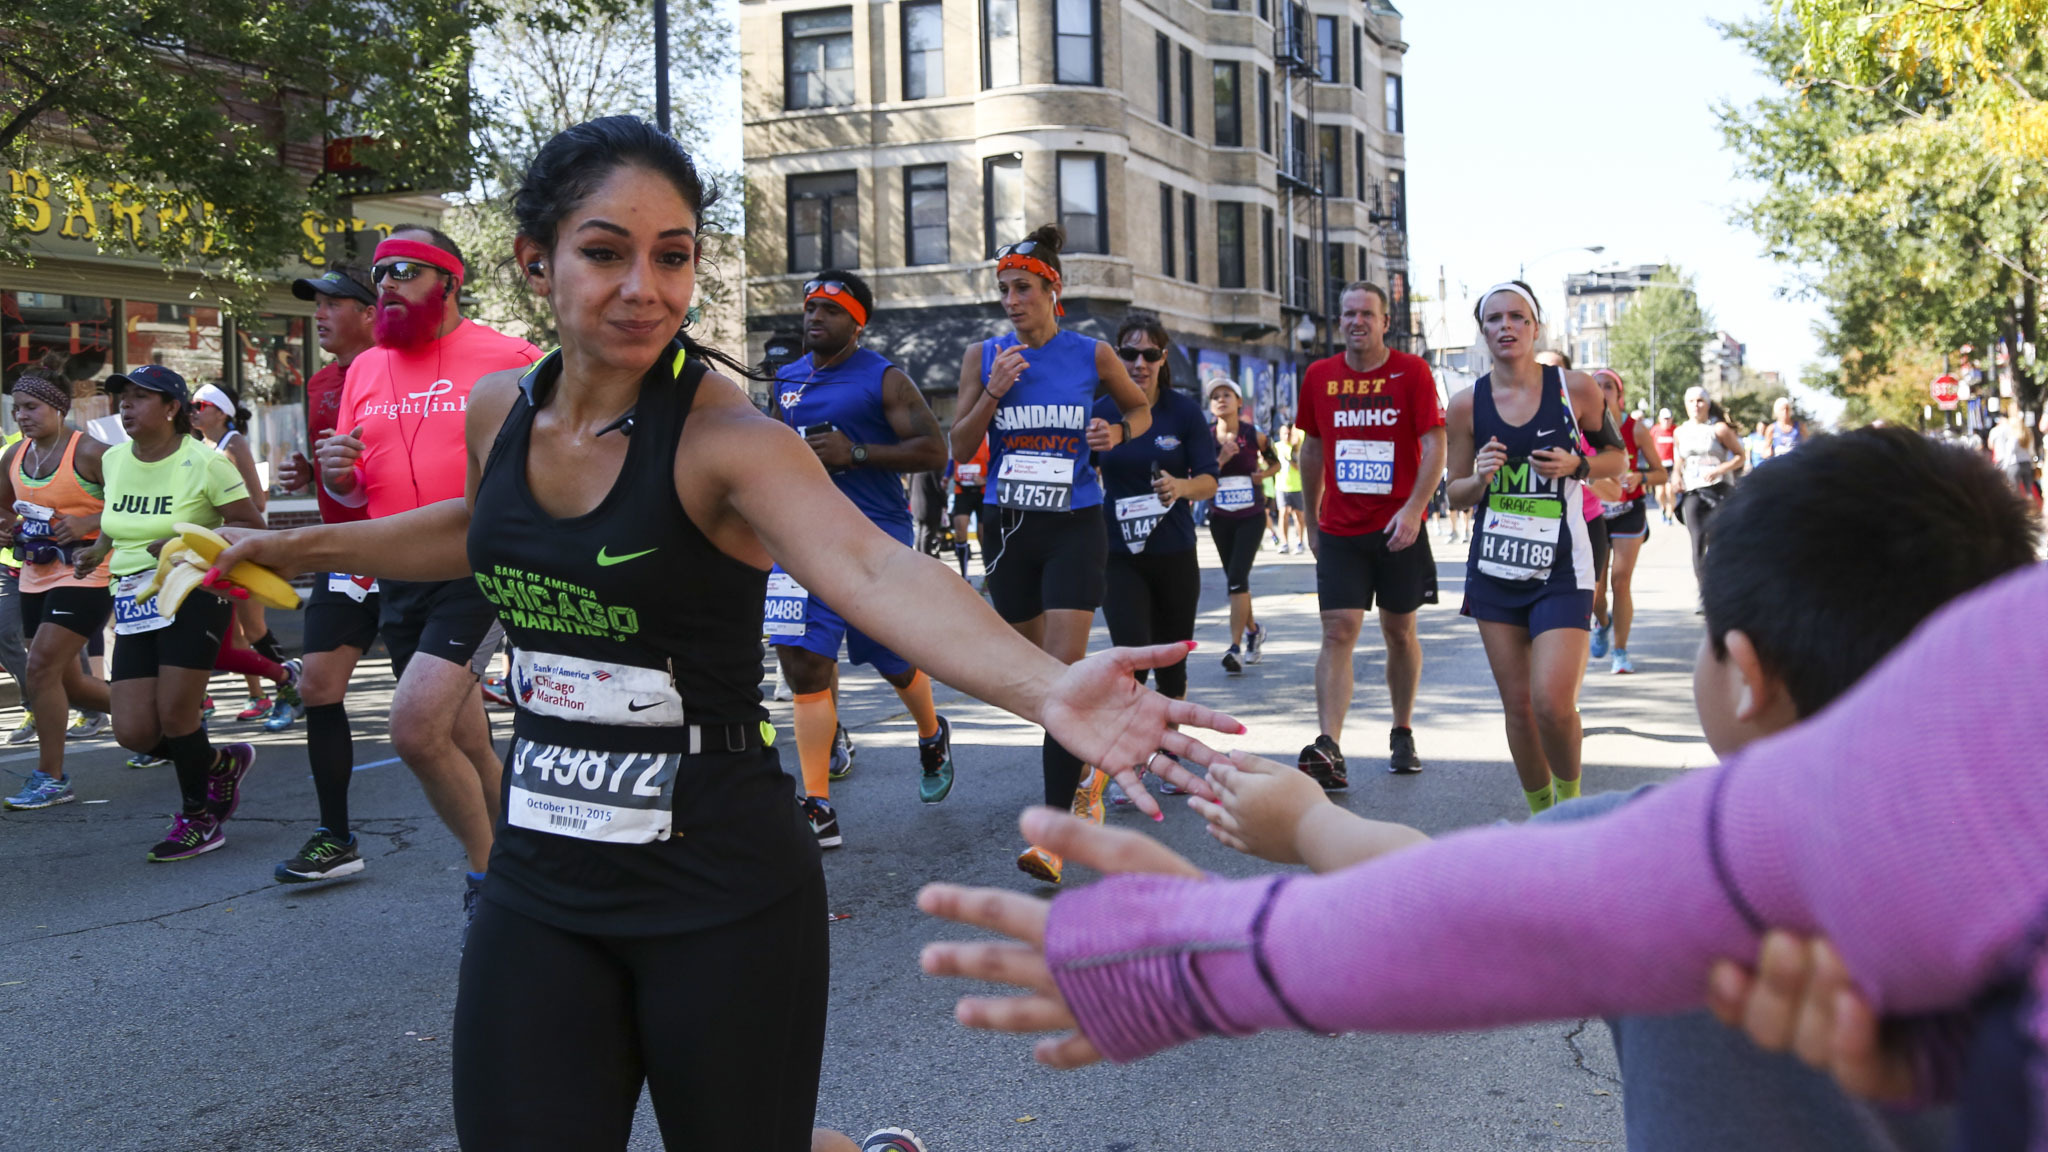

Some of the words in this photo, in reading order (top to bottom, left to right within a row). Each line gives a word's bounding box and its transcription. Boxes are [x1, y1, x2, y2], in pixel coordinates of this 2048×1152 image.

[1326, 379, 1386, 396] BRET
[364, 398, 421, 420] bright
[1337, 394, 1393, 410] Team
[994, 404, 1085, 431] SANDANA
[1333, 408, 1399, 428] RMHC
[1336, 461, 1346, 480] G
[1348, 462, 1391, 482] 31520
[112, 494, 173, 515] JULIE
[1000, 482, 1010, 504] J
[1013, 483, 1068, 508] 47577
[1499, 497, 1536, 513] GRACE
[1121, 522, 1132, 541] H
[1134, 516, 1163, 538] 441
[1483, 535, 1496, 559] H
[1498, 539, 1554, 568] 41189
[494, 565, 524, 580] BANK
[527, 572, 541, 583] OF
[544, 577, 597, 600] AMERICA
[121, 595, 158, 619] 2303
[475, 571, 639, 635] CHICAGO
[533, 663, 551, 674] Bank
[552, 666, 560, 675] of
[559, 667, 590, 680] America
[535, 675, 575, 695] Chicago
[536, 688, 586, 711] Marathon
[514, 740, 534, 775] J
[532, 744, 668, 797] 49872
[527, 798, 566, 814] October
[568, 804, 583, 818] 11,
[586, 808, 612, 822] 2015
